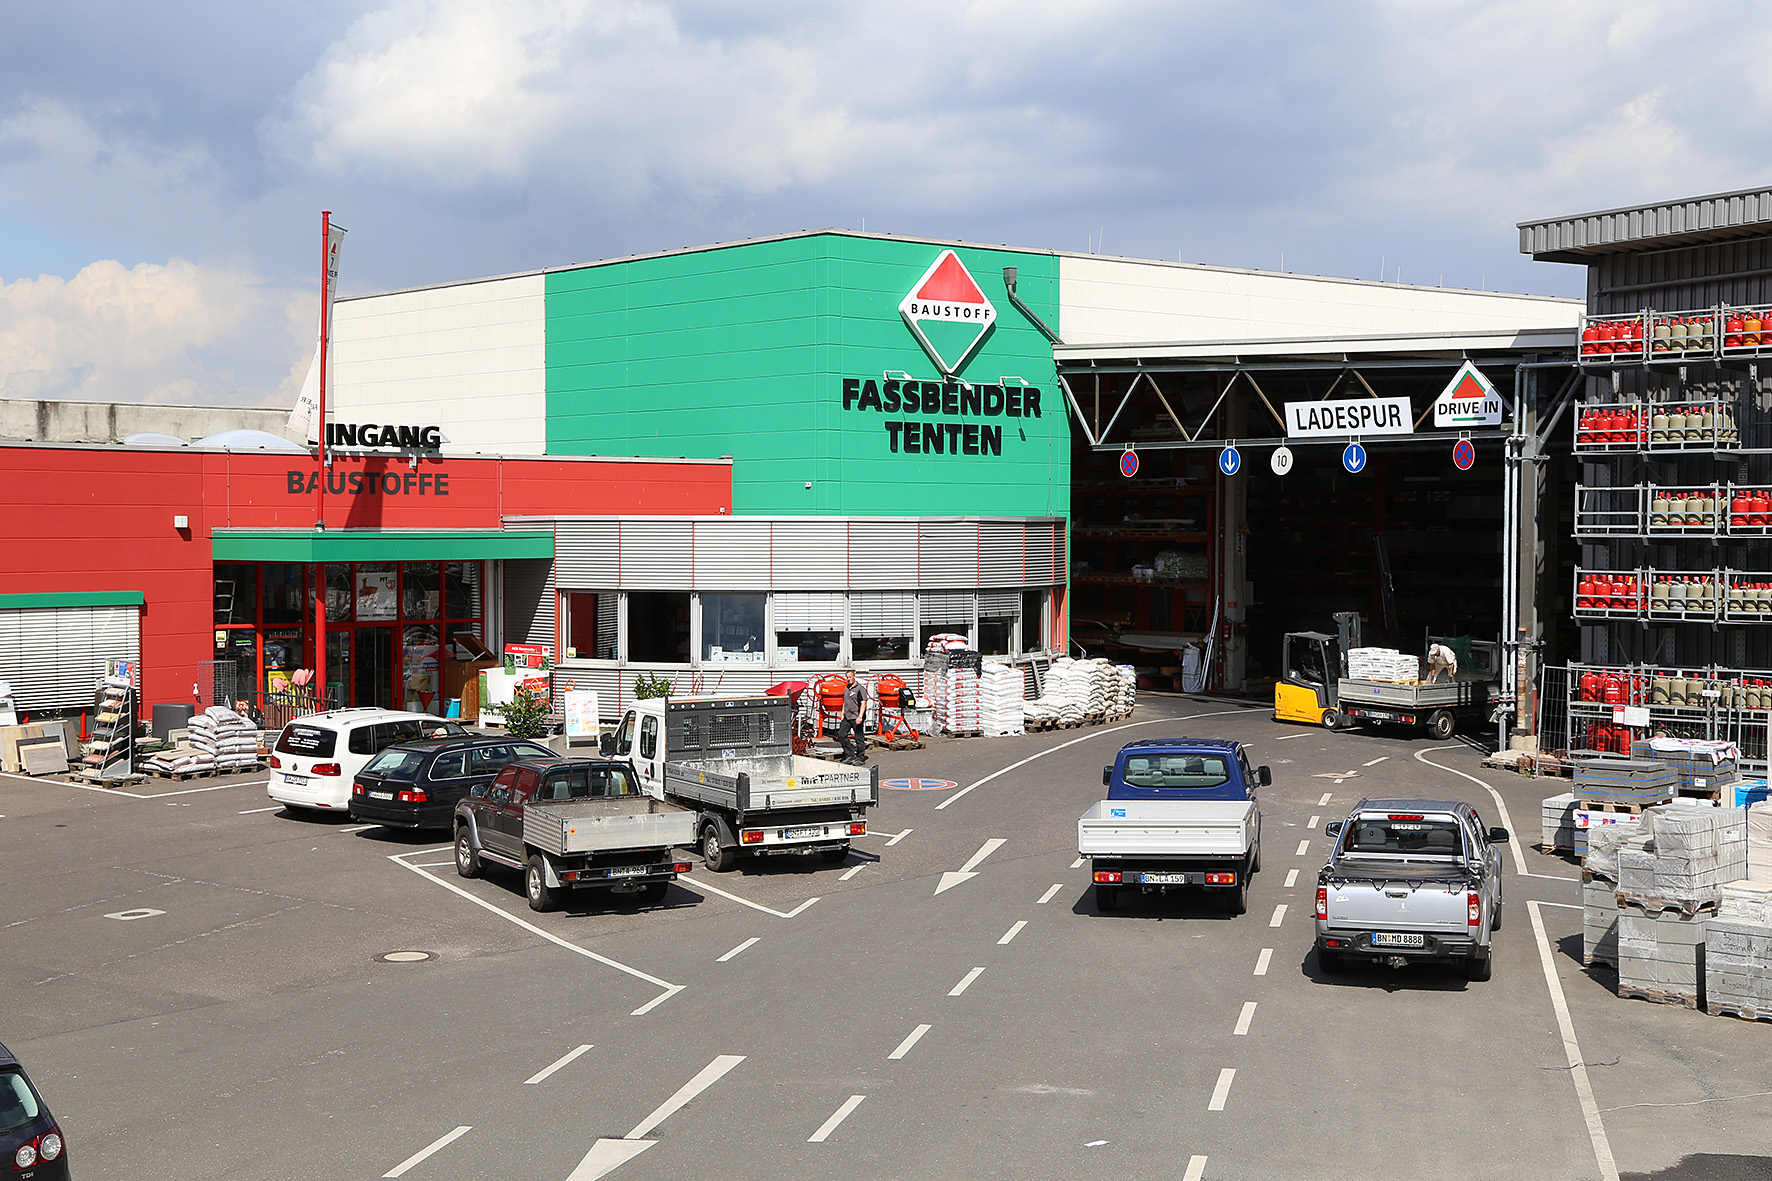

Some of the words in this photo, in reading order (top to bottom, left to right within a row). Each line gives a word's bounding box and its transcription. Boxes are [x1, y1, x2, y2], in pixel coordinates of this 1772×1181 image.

[911, 303, 990, 320] BAUSTOFF
[842, 378, 1042, 418] FASSBENDER
[1438, 402, 1479, 415] DRIVE
[1484, 401, 1499, 413] IN
[1296, 404, 1402, 430] LADESPUR
[308, 423, 441, 449] INGANG
[885, 421, 1002, 456] TENTEN
[1276, 455, 1288, 467] 10
[287, 471, 449, 495] BAUSTOFFE
[1391, 823, 1421, 831] ISUZU
[1377, 934, 1387, 942] BN
[1391, 935, 1402, 943] MD
[1403, 935, 1423, 943] 8888
